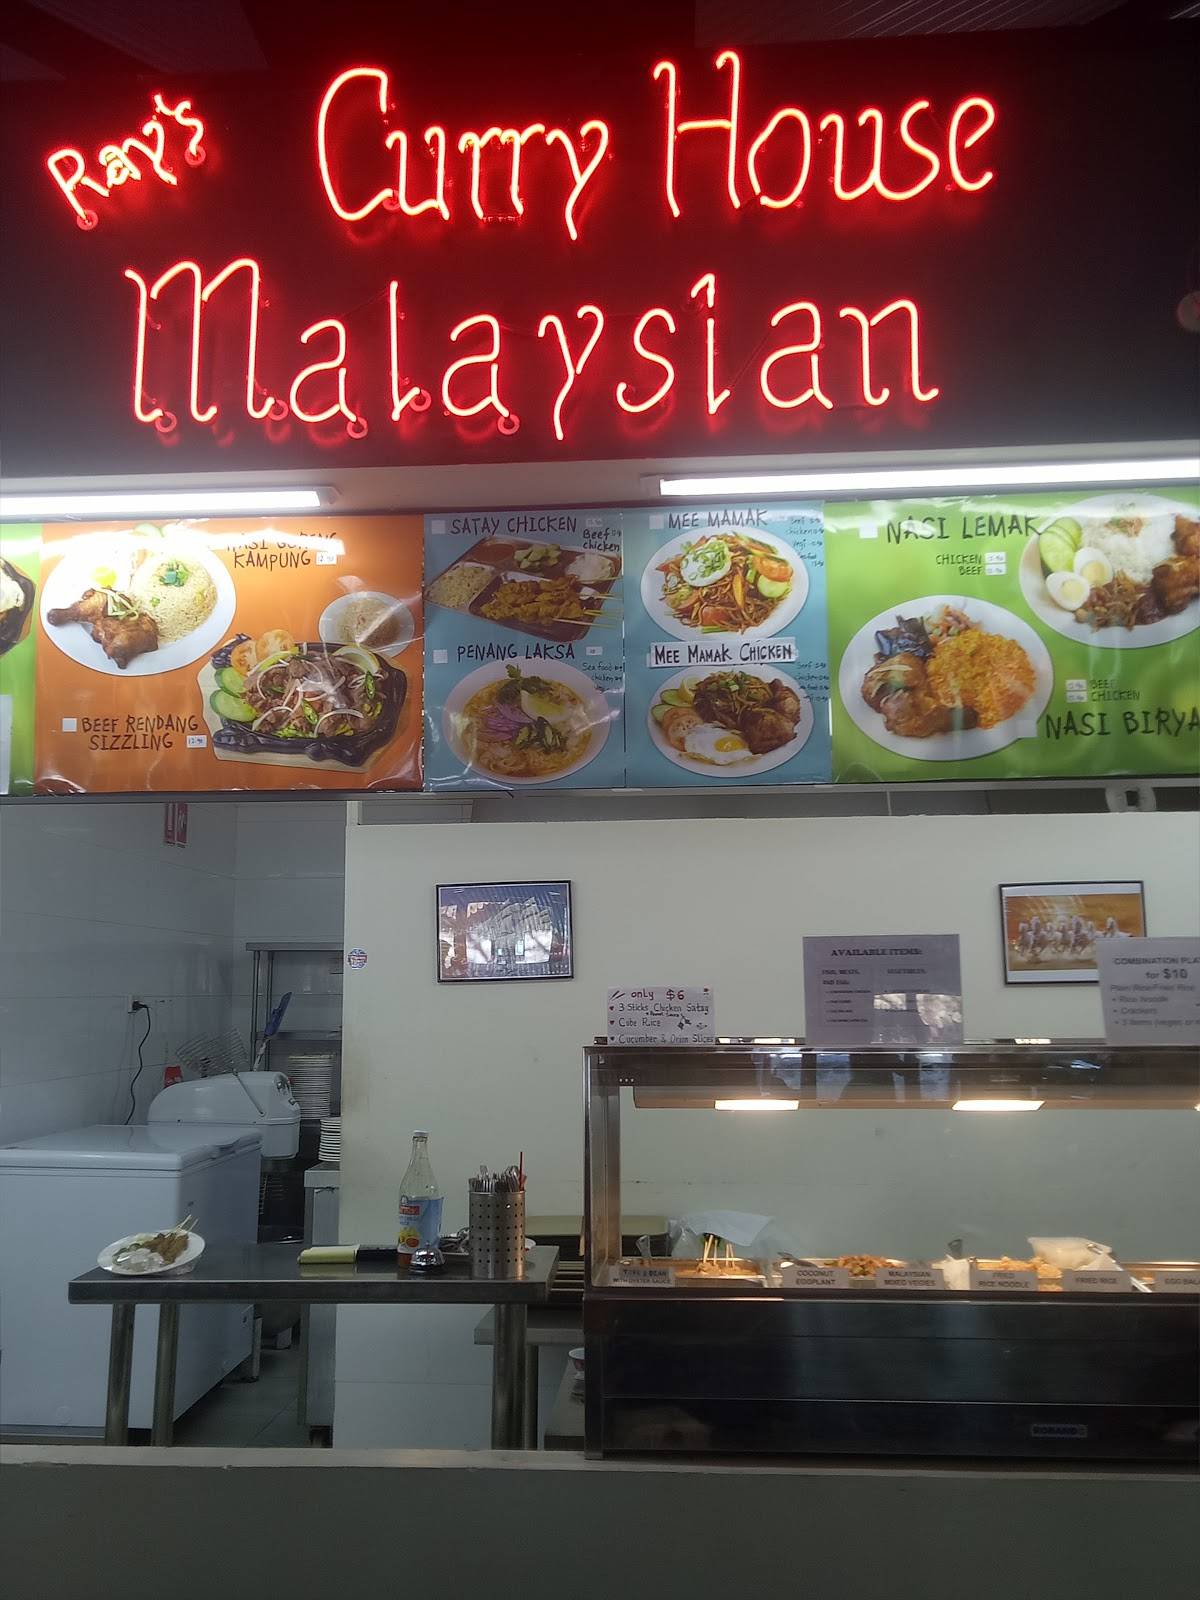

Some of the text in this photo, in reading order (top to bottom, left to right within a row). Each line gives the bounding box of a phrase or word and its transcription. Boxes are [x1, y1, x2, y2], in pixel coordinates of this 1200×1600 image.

[317, 50, 996, 241] Curry House
[125, 257, 940, 440] Malaysian
[450, 516, 500, 536] SATAY
[507, 515, 577, 534] CHICKEN
[668, 508, 768, 529] MEE MAMAK
[962, 514, 1040, 539] LEMAK
[234, 550, 311, 571] KAMPUNG
[936, 554, 982, 565] CHICKEN
[458, 644, 517, 661] PENANG
[525, 643, 575, 660] LAKSA
[655, 641, 792, 664] MEE MAMAK CHICKEN
[82, 714, 199, 733] BEEF RENDANG
[1045, 710, 1111, 740] NASI
[89, 732, 173, 751] SIZZLING
[831, 949, 887, 957] AVAILABLE
[666, 989, 685, 1000] $6
[618, 1003, 625, 1012] 3
